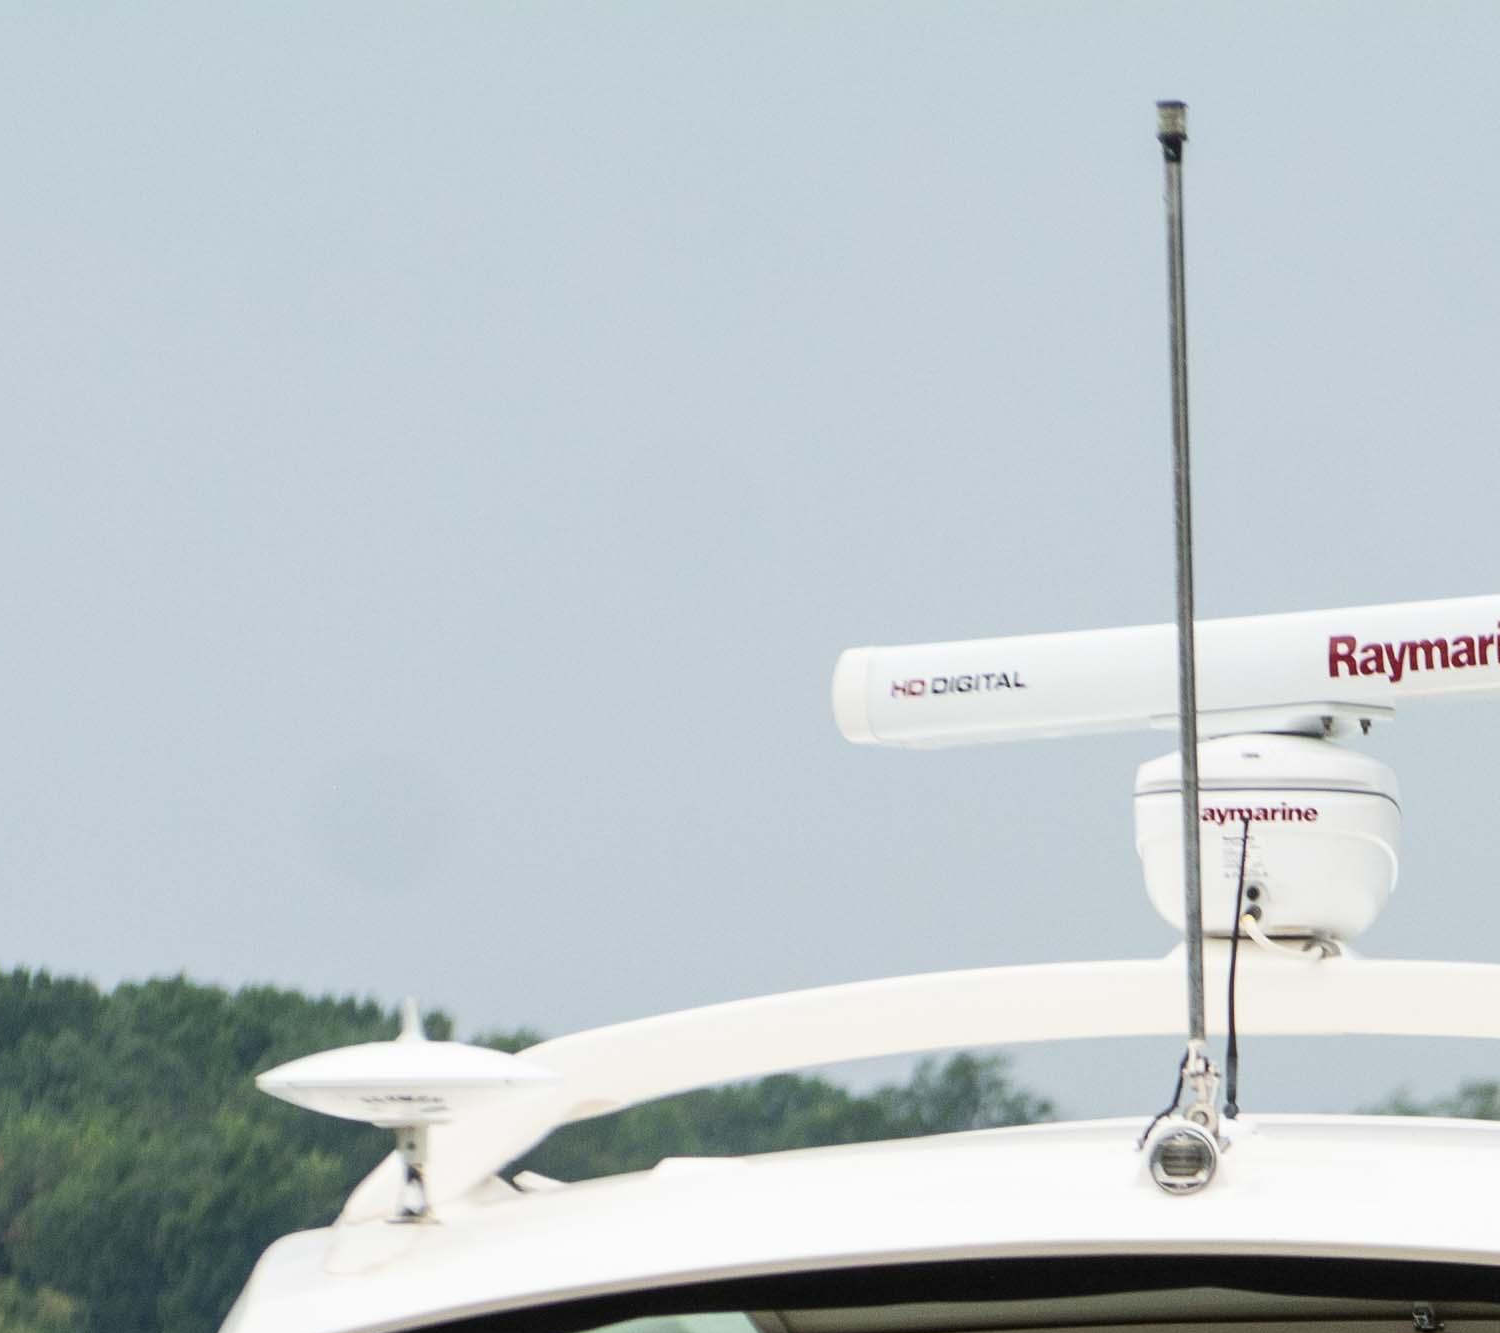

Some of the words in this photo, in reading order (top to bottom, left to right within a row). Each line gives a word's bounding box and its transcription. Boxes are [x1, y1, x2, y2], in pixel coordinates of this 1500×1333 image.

[889, 678, 927, 699] HD
[930, 671, 1028, 696] DIGITAL
[1200, 801, 1320, 827] aymarine
